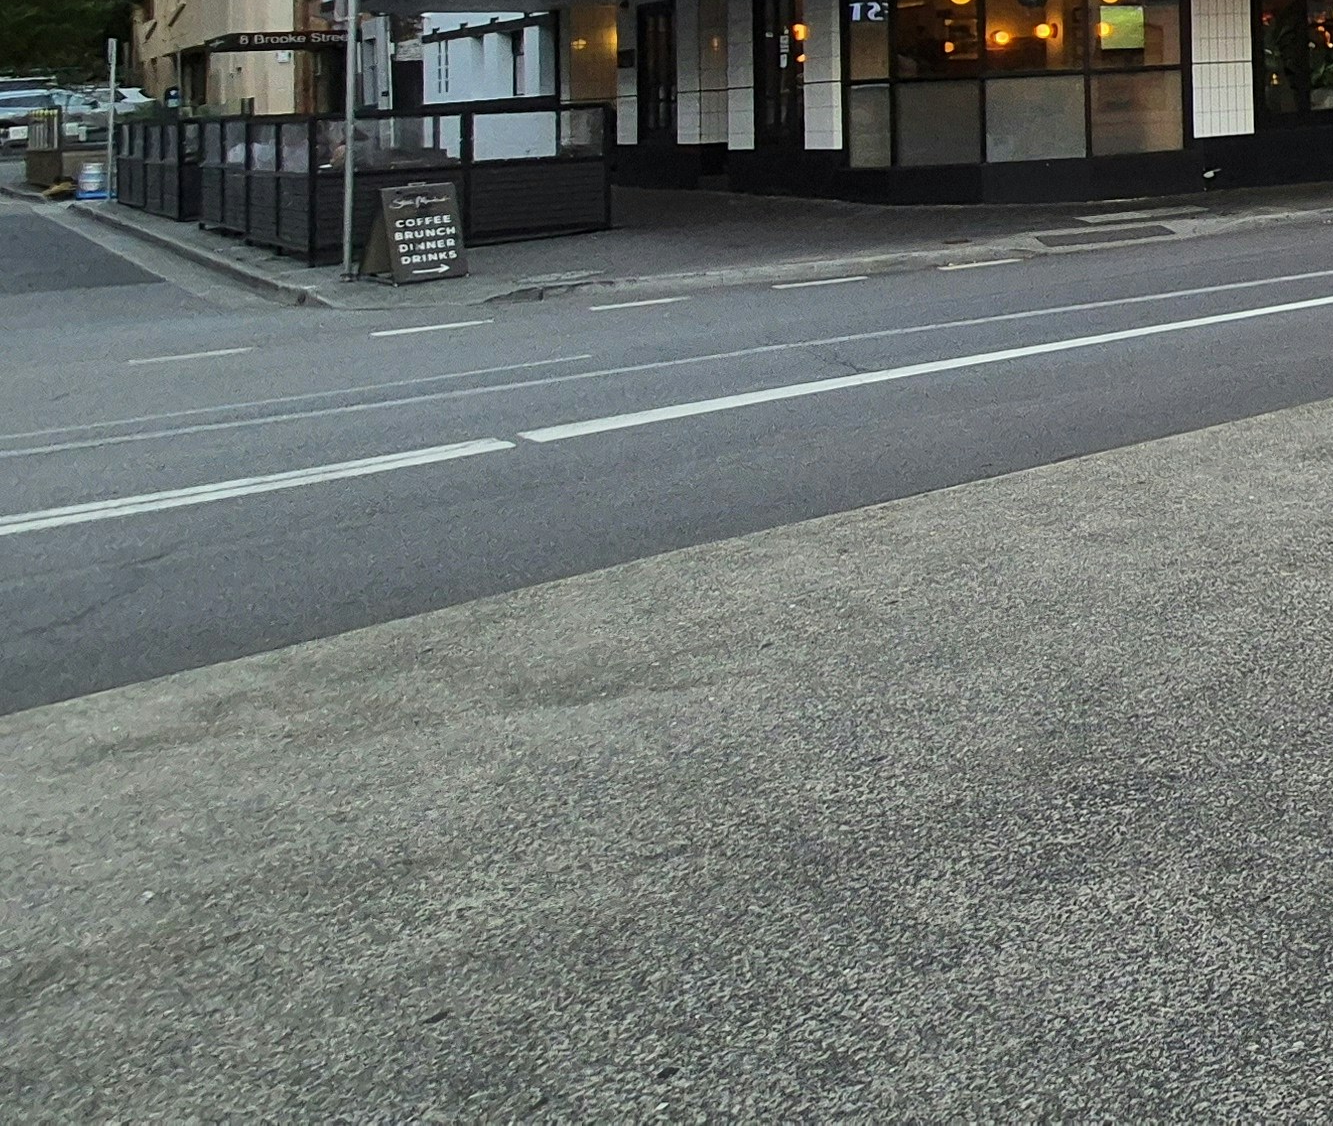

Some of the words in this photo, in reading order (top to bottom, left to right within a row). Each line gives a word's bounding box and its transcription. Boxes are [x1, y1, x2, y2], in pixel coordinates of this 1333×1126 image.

[239, 35, 248, 45] 8
[254, 34, 306, 44] Brooke
[311, 32, 348, 43] Stree
[395, 215, 451, 227] COFFEE
[394, 227, 455, 241] BRUNCH
[399, 239, 455, 253] DINNER
[401, 251, 457, 264] DRINKS
